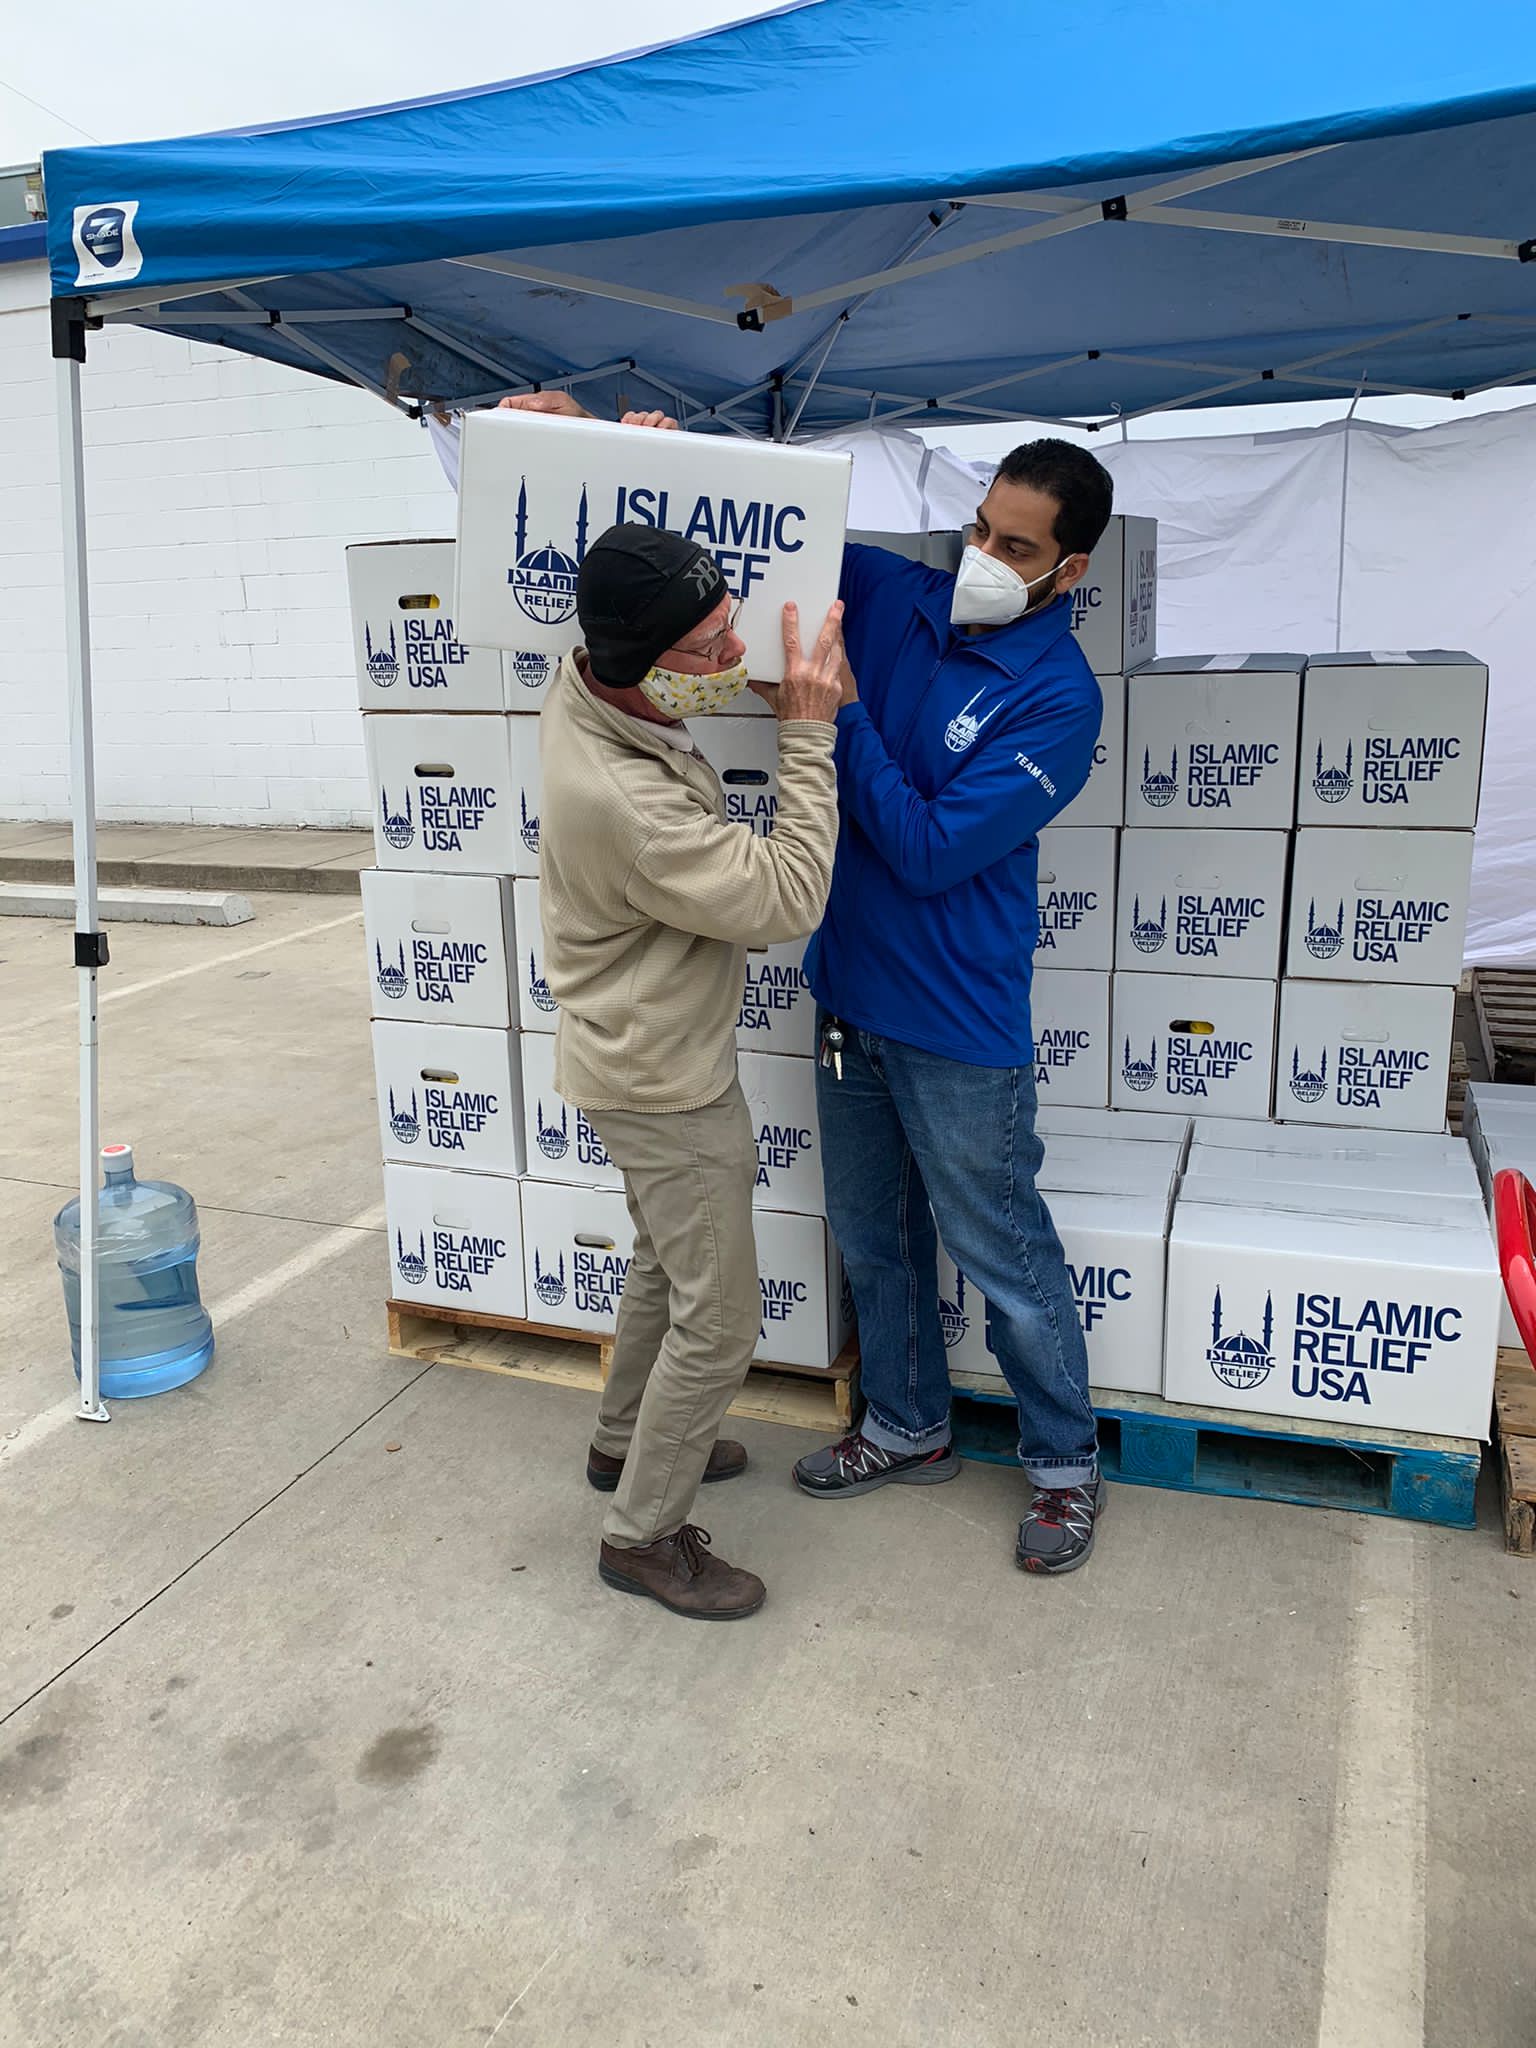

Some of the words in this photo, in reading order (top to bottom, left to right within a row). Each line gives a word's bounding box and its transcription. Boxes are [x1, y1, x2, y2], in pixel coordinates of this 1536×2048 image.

[524, 594, 573, 610] RELIEF
[406, 643, 470, 664] RELIEF
[408, 666, 448, 688] USA
[1190, 744, 1279, 764] ISLAMIC
[1366, 738, 1460, 758] ISLAMIC
[1014, 752, 1042, 778] TEAM
[1188, 766, 1263, 786] RELIEF
[1364, 760, 1444, 782] RELIEF
[420, 786, 497, 808] ISLAMIC
[1188, 788, 1231, 808] USA
[1363, 783, 1408, 804] USA
[422, 809, 485, 830] RELIEF
[424, 831, 463, 852] USA
[1178, 896, 1265, 918] ISLAMIC
[1356, 899, 1450, 922] ISLAMIC
[1177, 916, 1250, 938] RELIEF
[1354, 920, 1432, 942] RELIEF
[412, 940, 488, 964] ISLAMIC
[1176, 936, 1218, 956] USA
[1353, 942, 1398, 962] USA
[414, 962, 476, 984] RELIEF
[746, 964, 810, 990] LAMIC
[416, 982, 454, 1004] USA
[743, 986, 799, 1010] ELIEF
[1036, 1048, 1076, 1066] LIEF
[1168, 1038, 1253, 1060] ISLAMIC
[1340, 1047, 1430, 1070] ISLAMIC
[1167, 1057, 1238, 1078] RELIEF
[1338, 1067, 1413, 1090] RELIEF
[1166, 1076, 1208, 1096] USA
[425, 1088, 498, 1114] ISLAMIC
[1336, 1087, 1380, 1108] USA
[426, 1109, 487, 1132] RELIEF
[428, 1128, 464, 1150] USA
[434, 1232, 506, 1258] ISLAMIC
[434, 1251, 494, 1275] RELIEF
[574, 1252, 631, 1276] ISLAM
[436, 1270, 472, 1292] USA
[574, 1272, 626, 1296] RELIE
[576, 1292, 614, 1314] USA
[1296, 1293, 1462, 1342] ISLAMIC
[1206, 1350, 1276, 1368] ISLAMIC
[1294, 1330, 1432, 1374] RELIEF
[1220, 1367, 1262, 1380] RELIEF
[1292, 1364, 1371, 1404] USA
